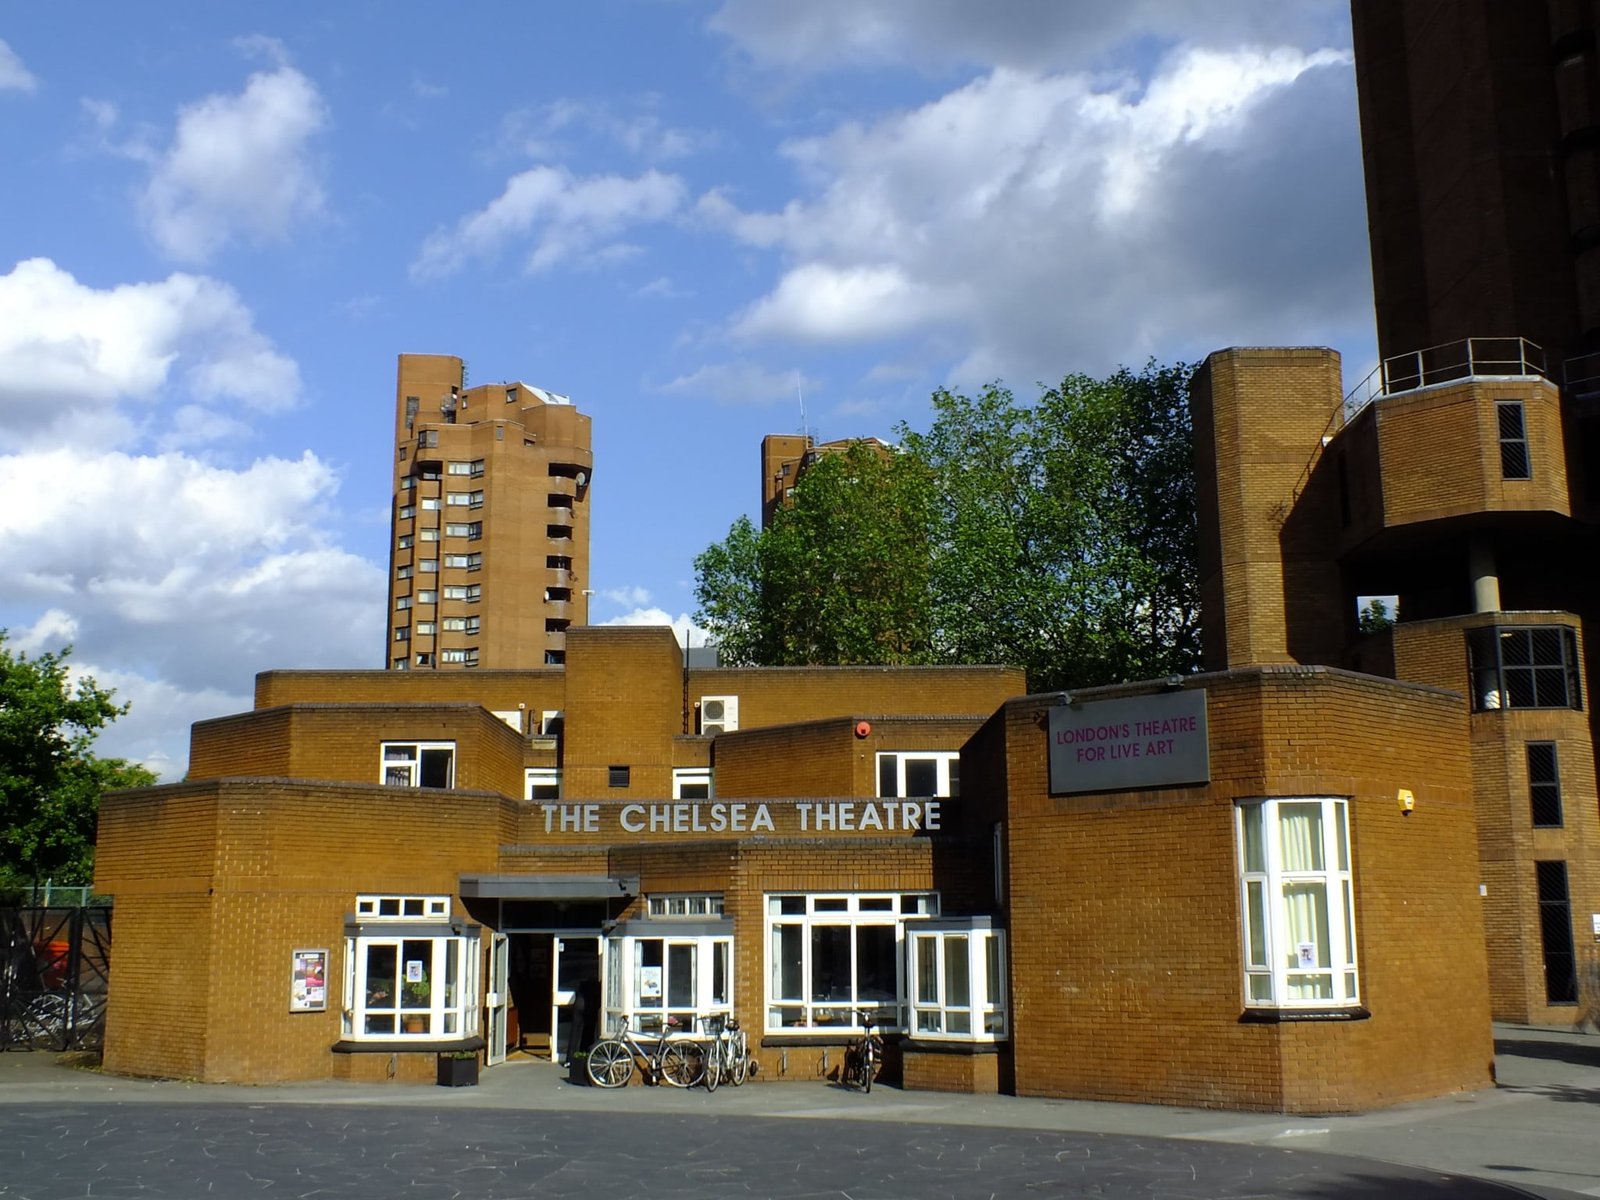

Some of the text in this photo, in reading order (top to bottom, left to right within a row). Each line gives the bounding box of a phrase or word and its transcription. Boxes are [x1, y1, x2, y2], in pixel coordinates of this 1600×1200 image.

[1057, 716, 1197, 745] LONDON'S THEATRE
[1077, 740, 1175, 762] FOR LIVE ART
[542, 802, 941, 833] THE CHELSEA THEATRE
